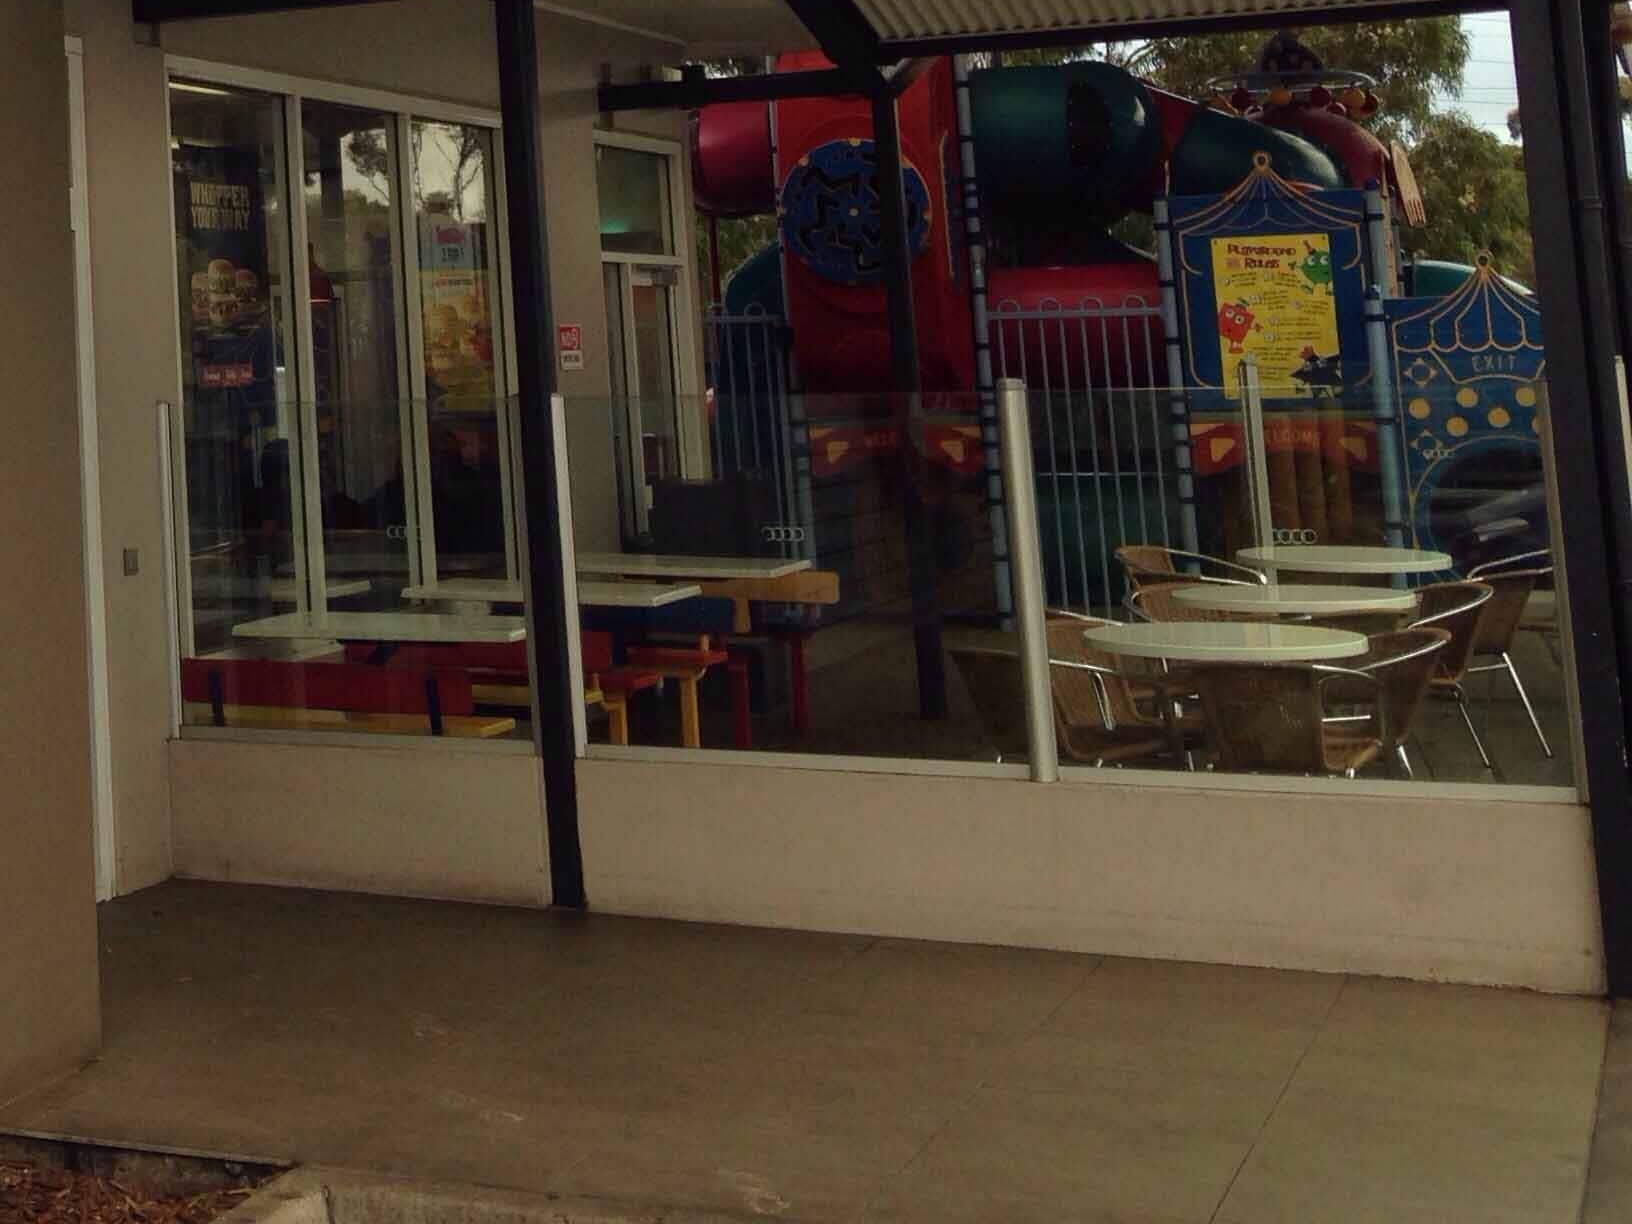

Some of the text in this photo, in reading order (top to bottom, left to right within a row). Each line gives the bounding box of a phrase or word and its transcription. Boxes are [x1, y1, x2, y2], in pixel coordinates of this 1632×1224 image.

[1227, 243, 1296, 257] PLAYGROUND
[1244, 257, 1280, 270] RULES
[1472, 353, 1516, 373] EXIT
[1261, 430, 1321, 449] ELCOME
